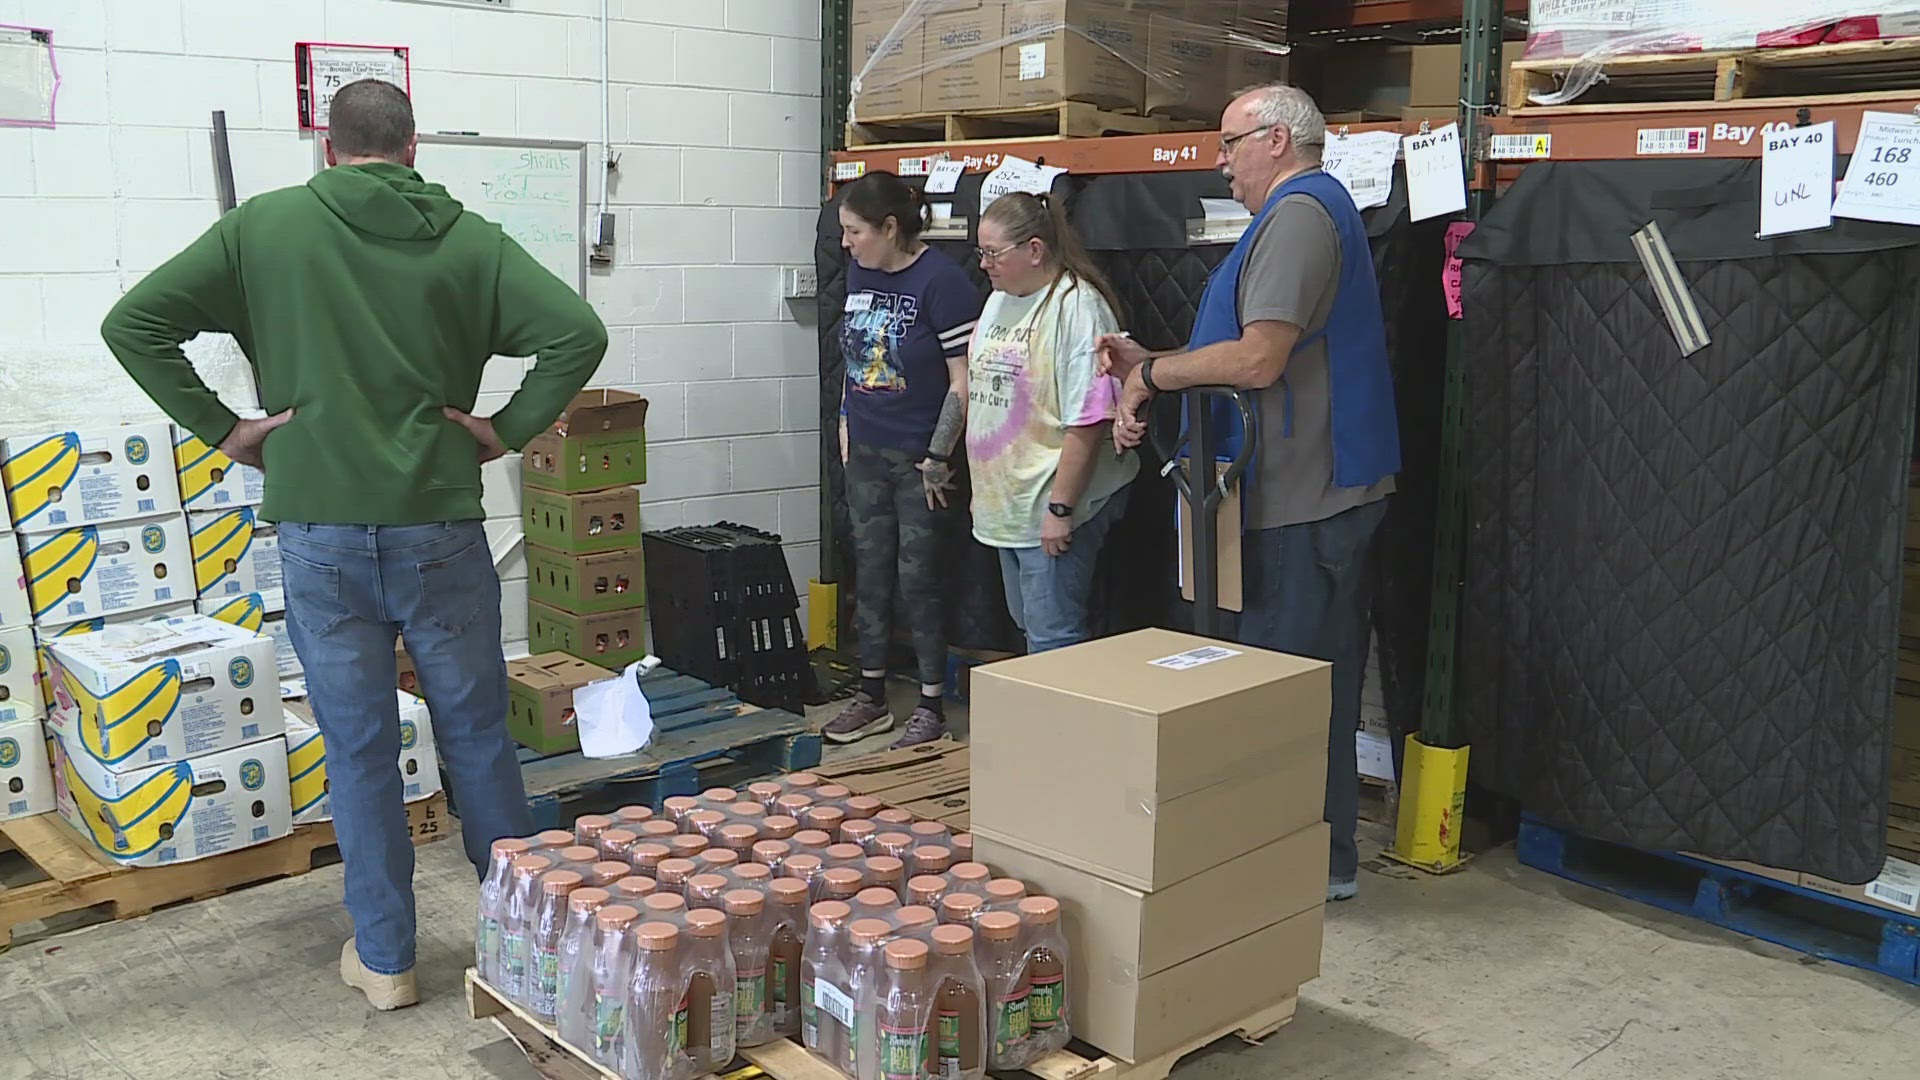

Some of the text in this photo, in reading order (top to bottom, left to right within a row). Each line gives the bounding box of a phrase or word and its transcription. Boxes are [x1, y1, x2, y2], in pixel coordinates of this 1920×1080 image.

[939, 30, 981, 45] HUNGER
[324, 75, 341, 88] 75
[1712, 123, 1755, 145] Bay
[1879, 126, 1913, 135] Midwest
[1413, 132, 1453, 151] BAY 41
[1535, 140, 1544, 153] A
[1769, 132, 1823, 151] BAY 40
[1893, 136, 1920, 146] Lunch
[518, 149, 571, 171] Shrink
[963, 153, 999, 170] Bay 42
[1154, 145, 1197, 165] Bay 41
[1870, 146, 1912, 164] 168
[1864, 172, 1899, 187] 460
[1774, 182, 1811, 207] UNL
[988, 392, 1009, 408] Cure
[420, 821, 438, 834] 25
[1031, 985, 1053, 996] imply
